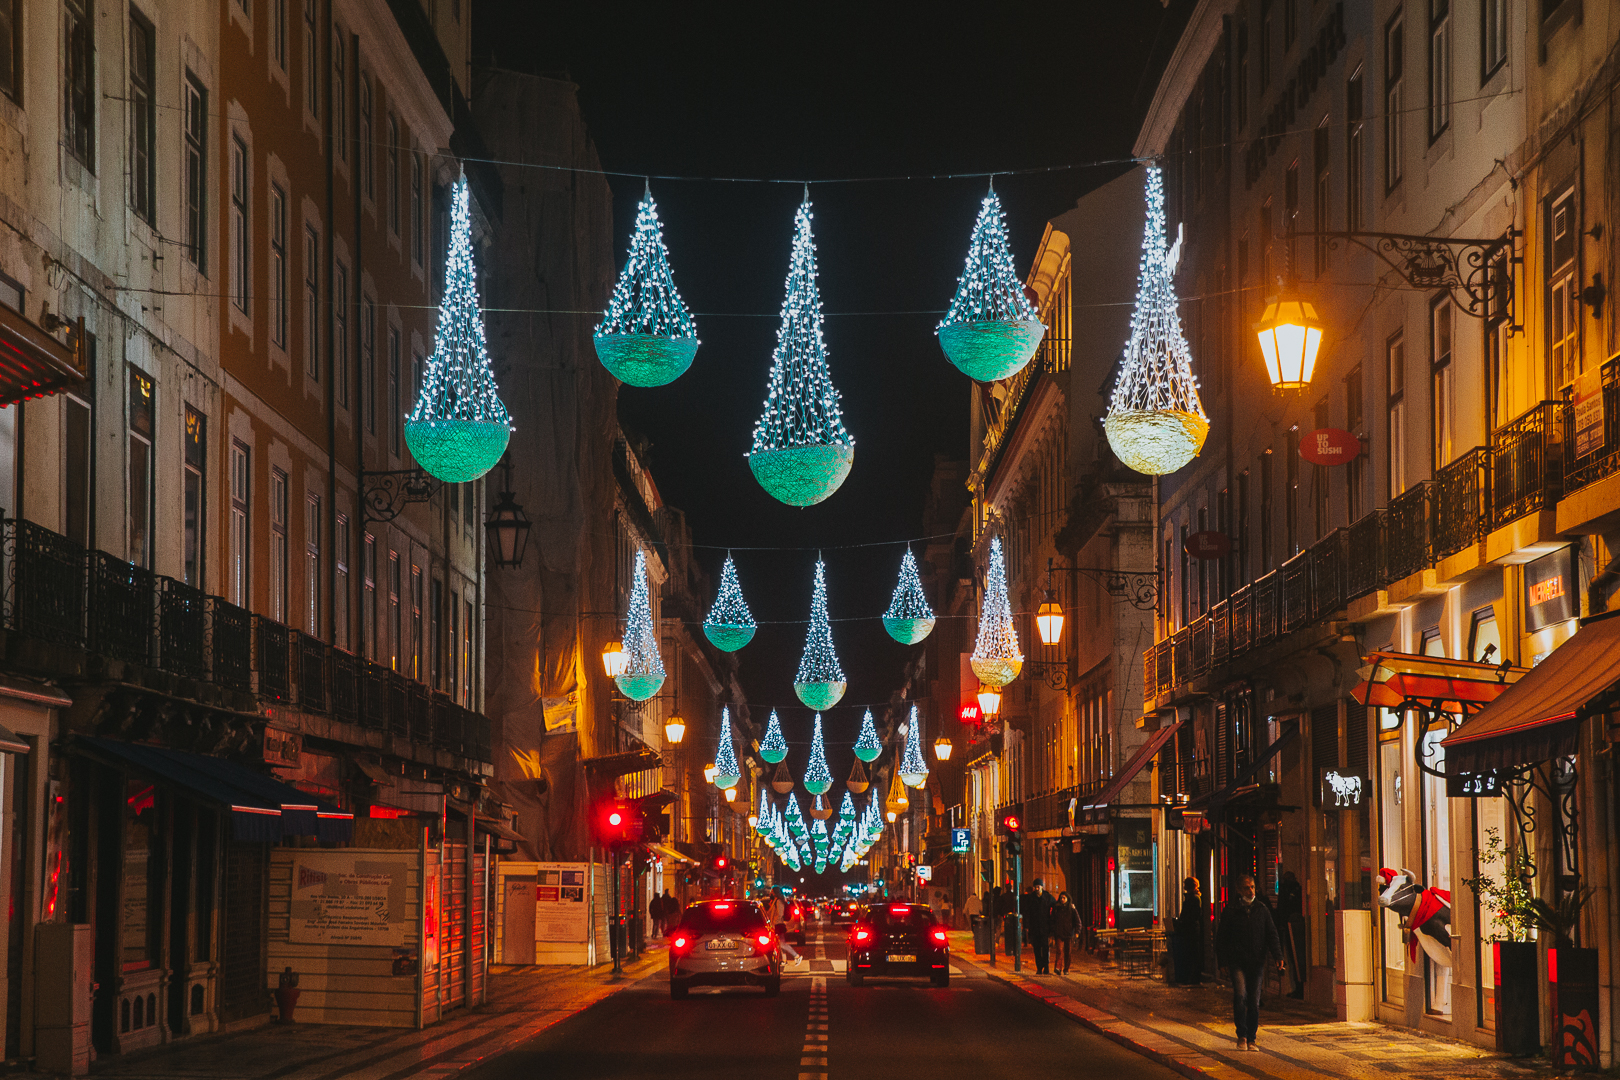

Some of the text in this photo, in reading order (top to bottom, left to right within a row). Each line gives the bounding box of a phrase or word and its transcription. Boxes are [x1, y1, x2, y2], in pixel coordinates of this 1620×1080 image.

[1316, 433, 1329, 441] UP
[1317, 447, 1343, 455] SUSHI
[957, 832, 966, 843] P
